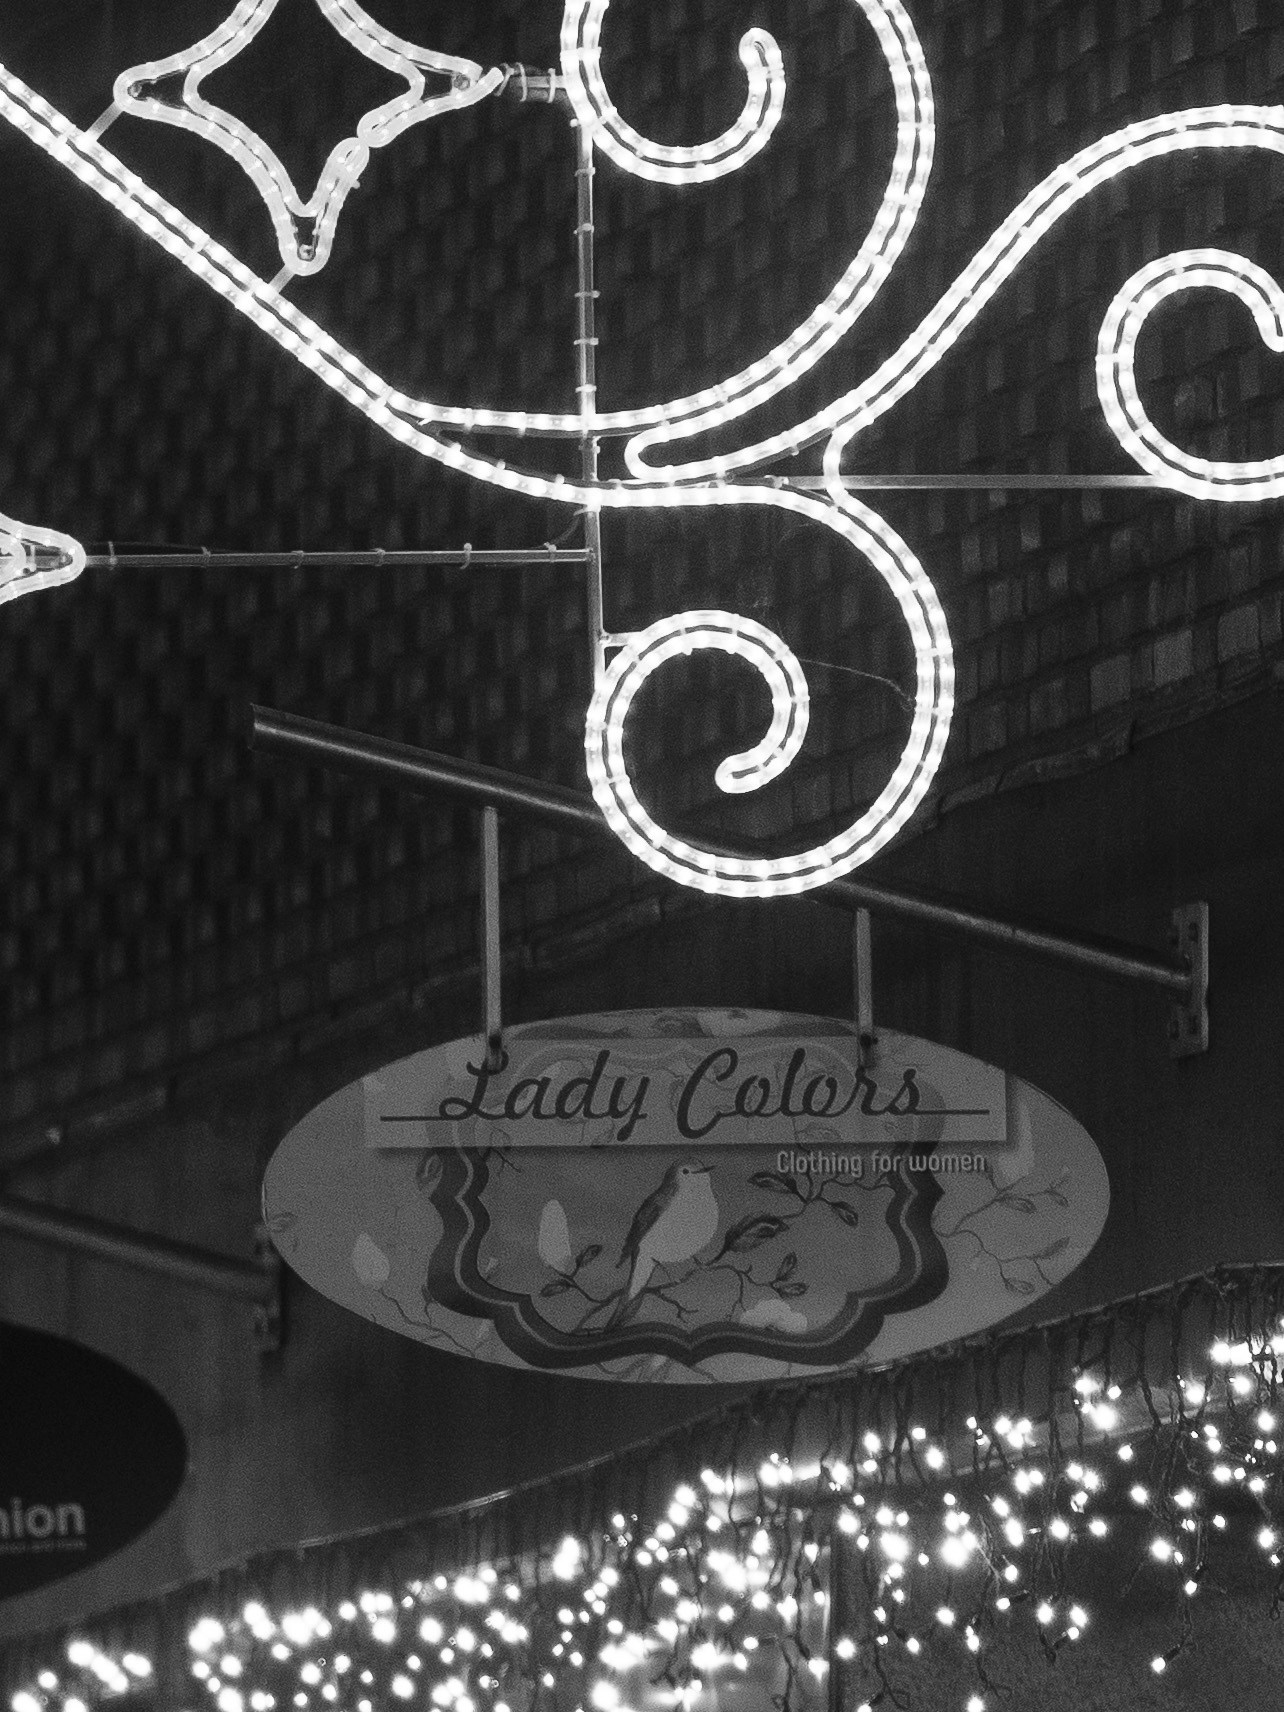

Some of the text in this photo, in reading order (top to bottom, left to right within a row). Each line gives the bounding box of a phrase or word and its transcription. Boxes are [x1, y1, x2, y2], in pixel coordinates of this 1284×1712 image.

[439, 1047, 923, 1142] Lady Colors
[776, 1150, 987, 1178] Clothing for women
